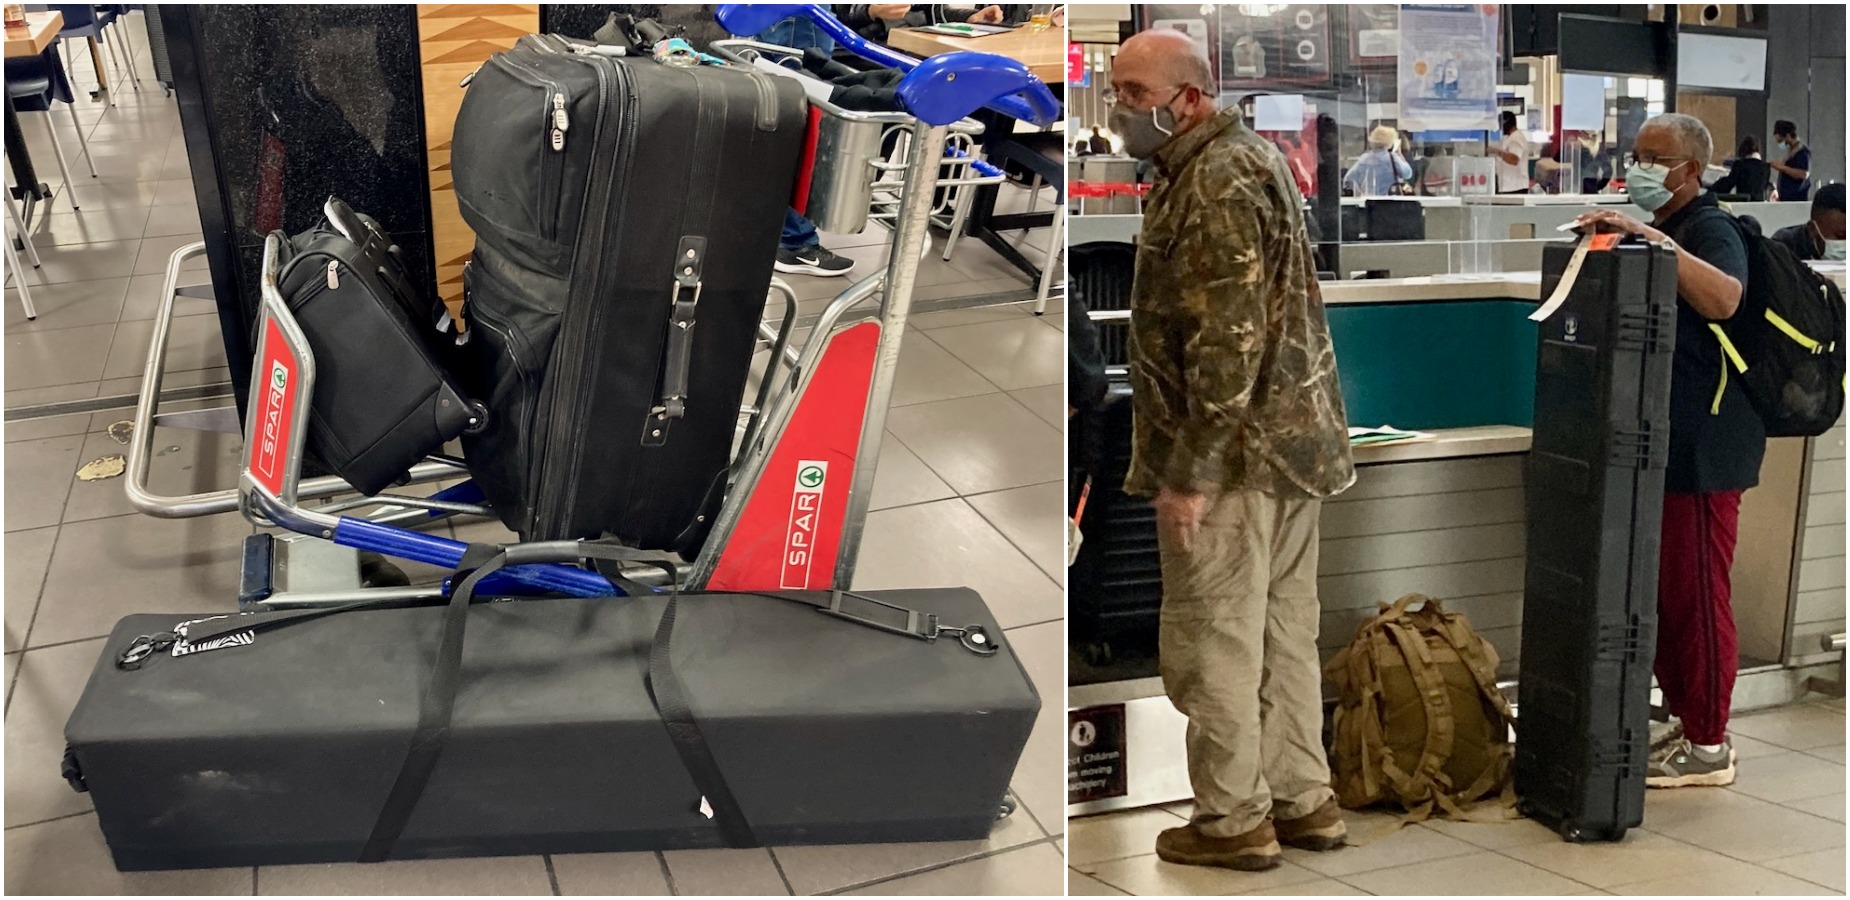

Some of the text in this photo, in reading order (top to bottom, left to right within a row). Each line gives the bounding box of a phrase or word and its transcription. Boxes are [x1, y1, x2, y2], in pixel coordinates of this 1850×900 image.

[264, 389, 282, 456] SPAR
[789, 494, 816, 566] SPAR
[1080, 766, 1112, 776] moving
[1084, 751, 1120, 763] Children
